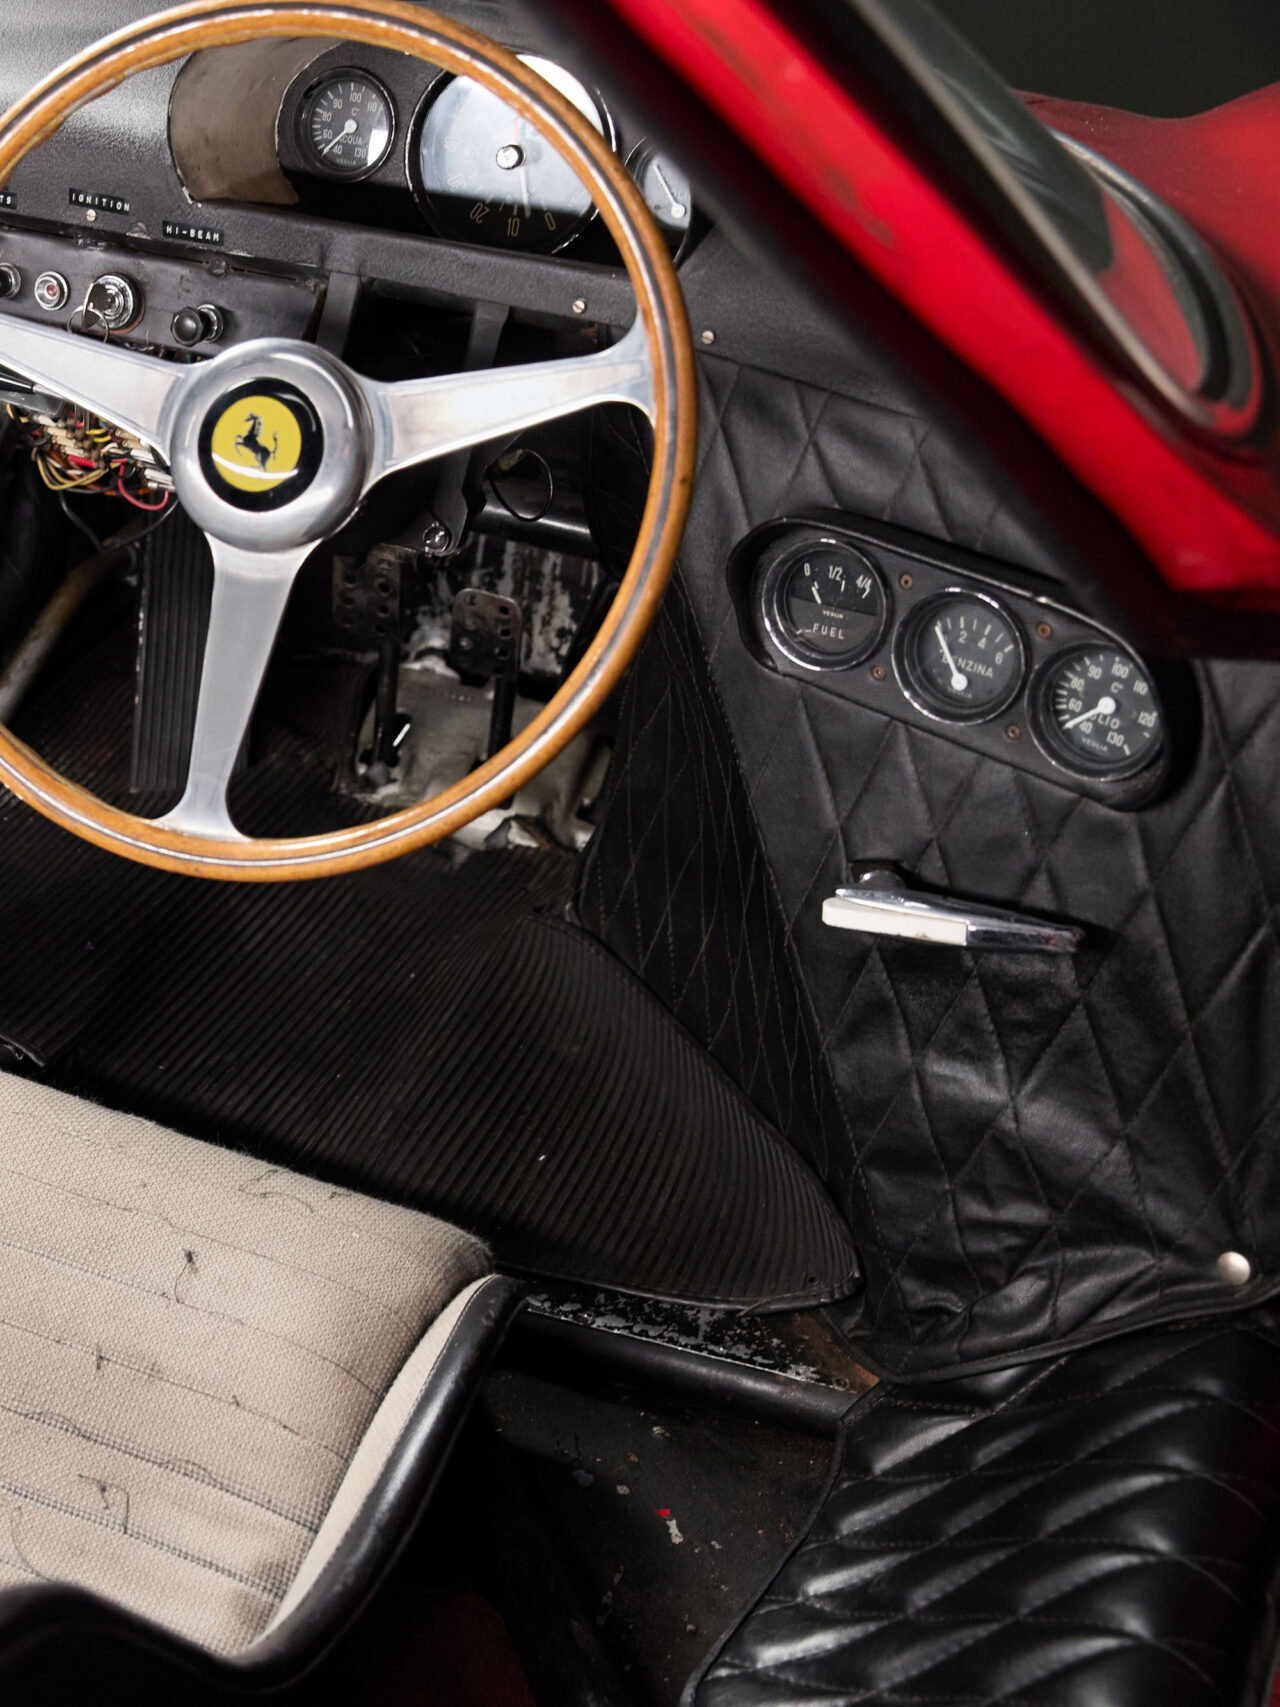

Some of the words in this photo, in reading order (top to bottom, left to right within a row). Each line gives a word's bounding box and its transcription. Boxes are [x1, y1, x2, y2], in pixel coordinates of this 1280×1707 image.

[332, 98, 343, 109] 90
[349, 92, 362, 103] 100
[367, 101, 378, 112] 110
[340, 134, 363, 145] CQUA
[332, 144, 343, 155] 40
[354, 147, 367, 158] 130
[71, 192, 131, 213] IGNITION
[506, 217, 520, 237] 10
[544, 211, 557, 231] 0
[165, 225, 220, 242] HI-BEAM
[803, 562, 811, 577] 0
[828, 565, 843, 581] 1/2
[812, 622, 845, 640] FUEL
[958, 630, 968, 644] 2
[977, 636, 987, 650] 4
[995, 651, 1004, 665] 6
[1087, 664, 1102, 680] 90
[1111, 662, 1129, 679] 100
[1070, 676, 1085, 691] 80
[1132, 679, 1148, 696] 110
[1067, 697, 1082, 713] 60
[1079, 720, 1093, 734] 40
[1137, 711, 1156, 728] 120
[1106, 731, 1125, 747] 130
